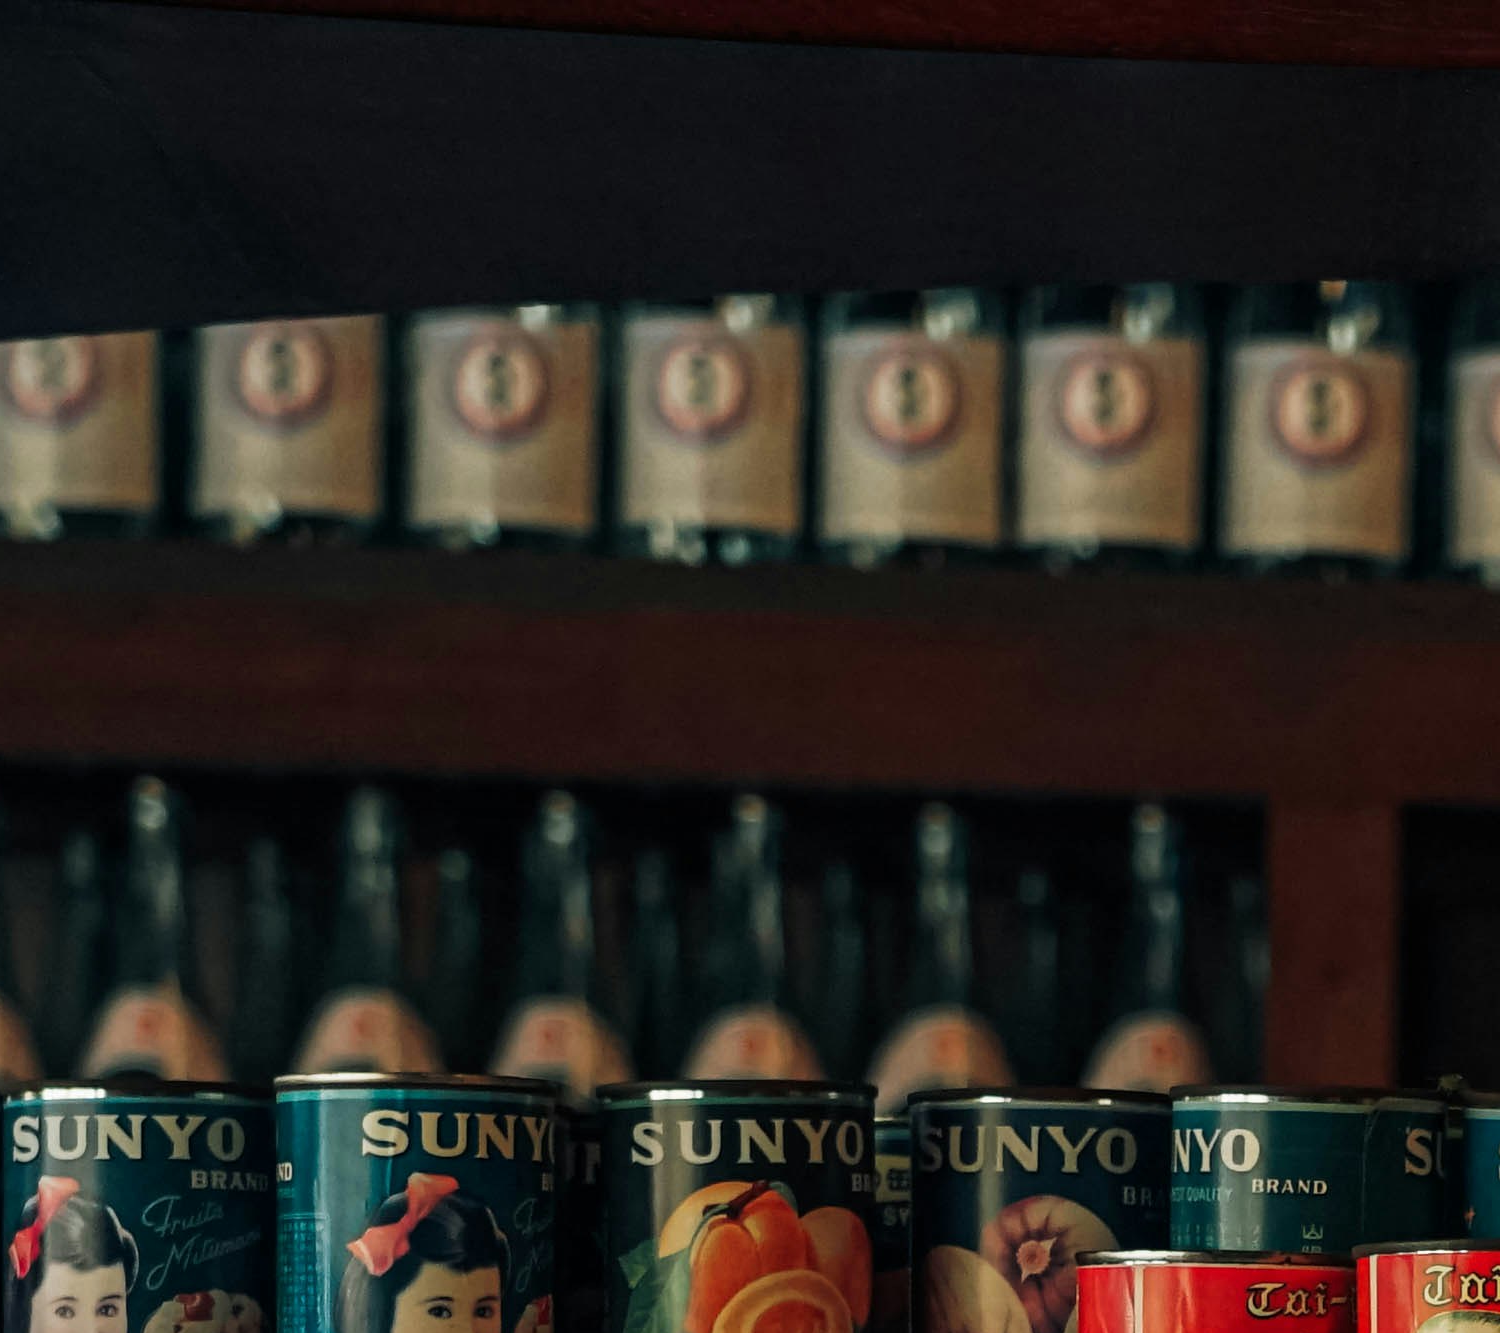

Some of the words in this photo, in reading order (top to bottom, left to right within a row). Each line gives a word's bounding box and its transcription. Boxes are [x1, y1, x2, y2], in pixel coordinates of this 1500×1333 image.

[12, 1112, 245, 1163] SUNYO
[630, 1119, 864, 1168] SUNYO
[923, 1126, 1138, 1176] SUNYO
[190, 1168, 269, 1194] BRAND
[1251, 1178, 1328, 1197] BRAND
